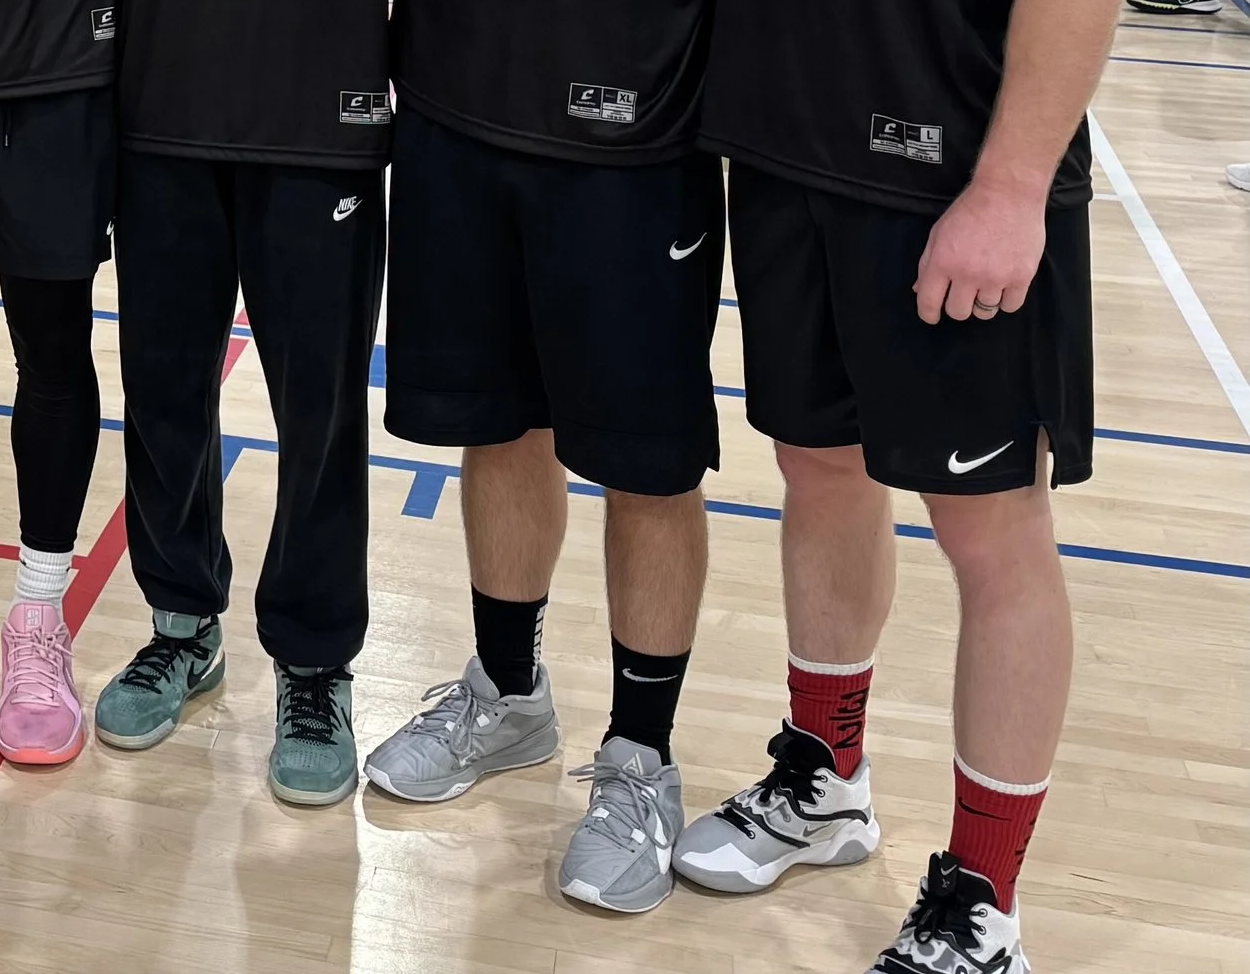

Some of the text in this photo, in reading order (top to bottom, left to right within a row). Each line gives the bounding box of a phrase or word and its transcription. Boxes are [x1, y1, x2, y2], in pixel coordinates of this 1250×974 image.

[619, 93, 632, 103] XL
[927, 130, 933, 140] L
[338, 196, 357, 212] NIKE
